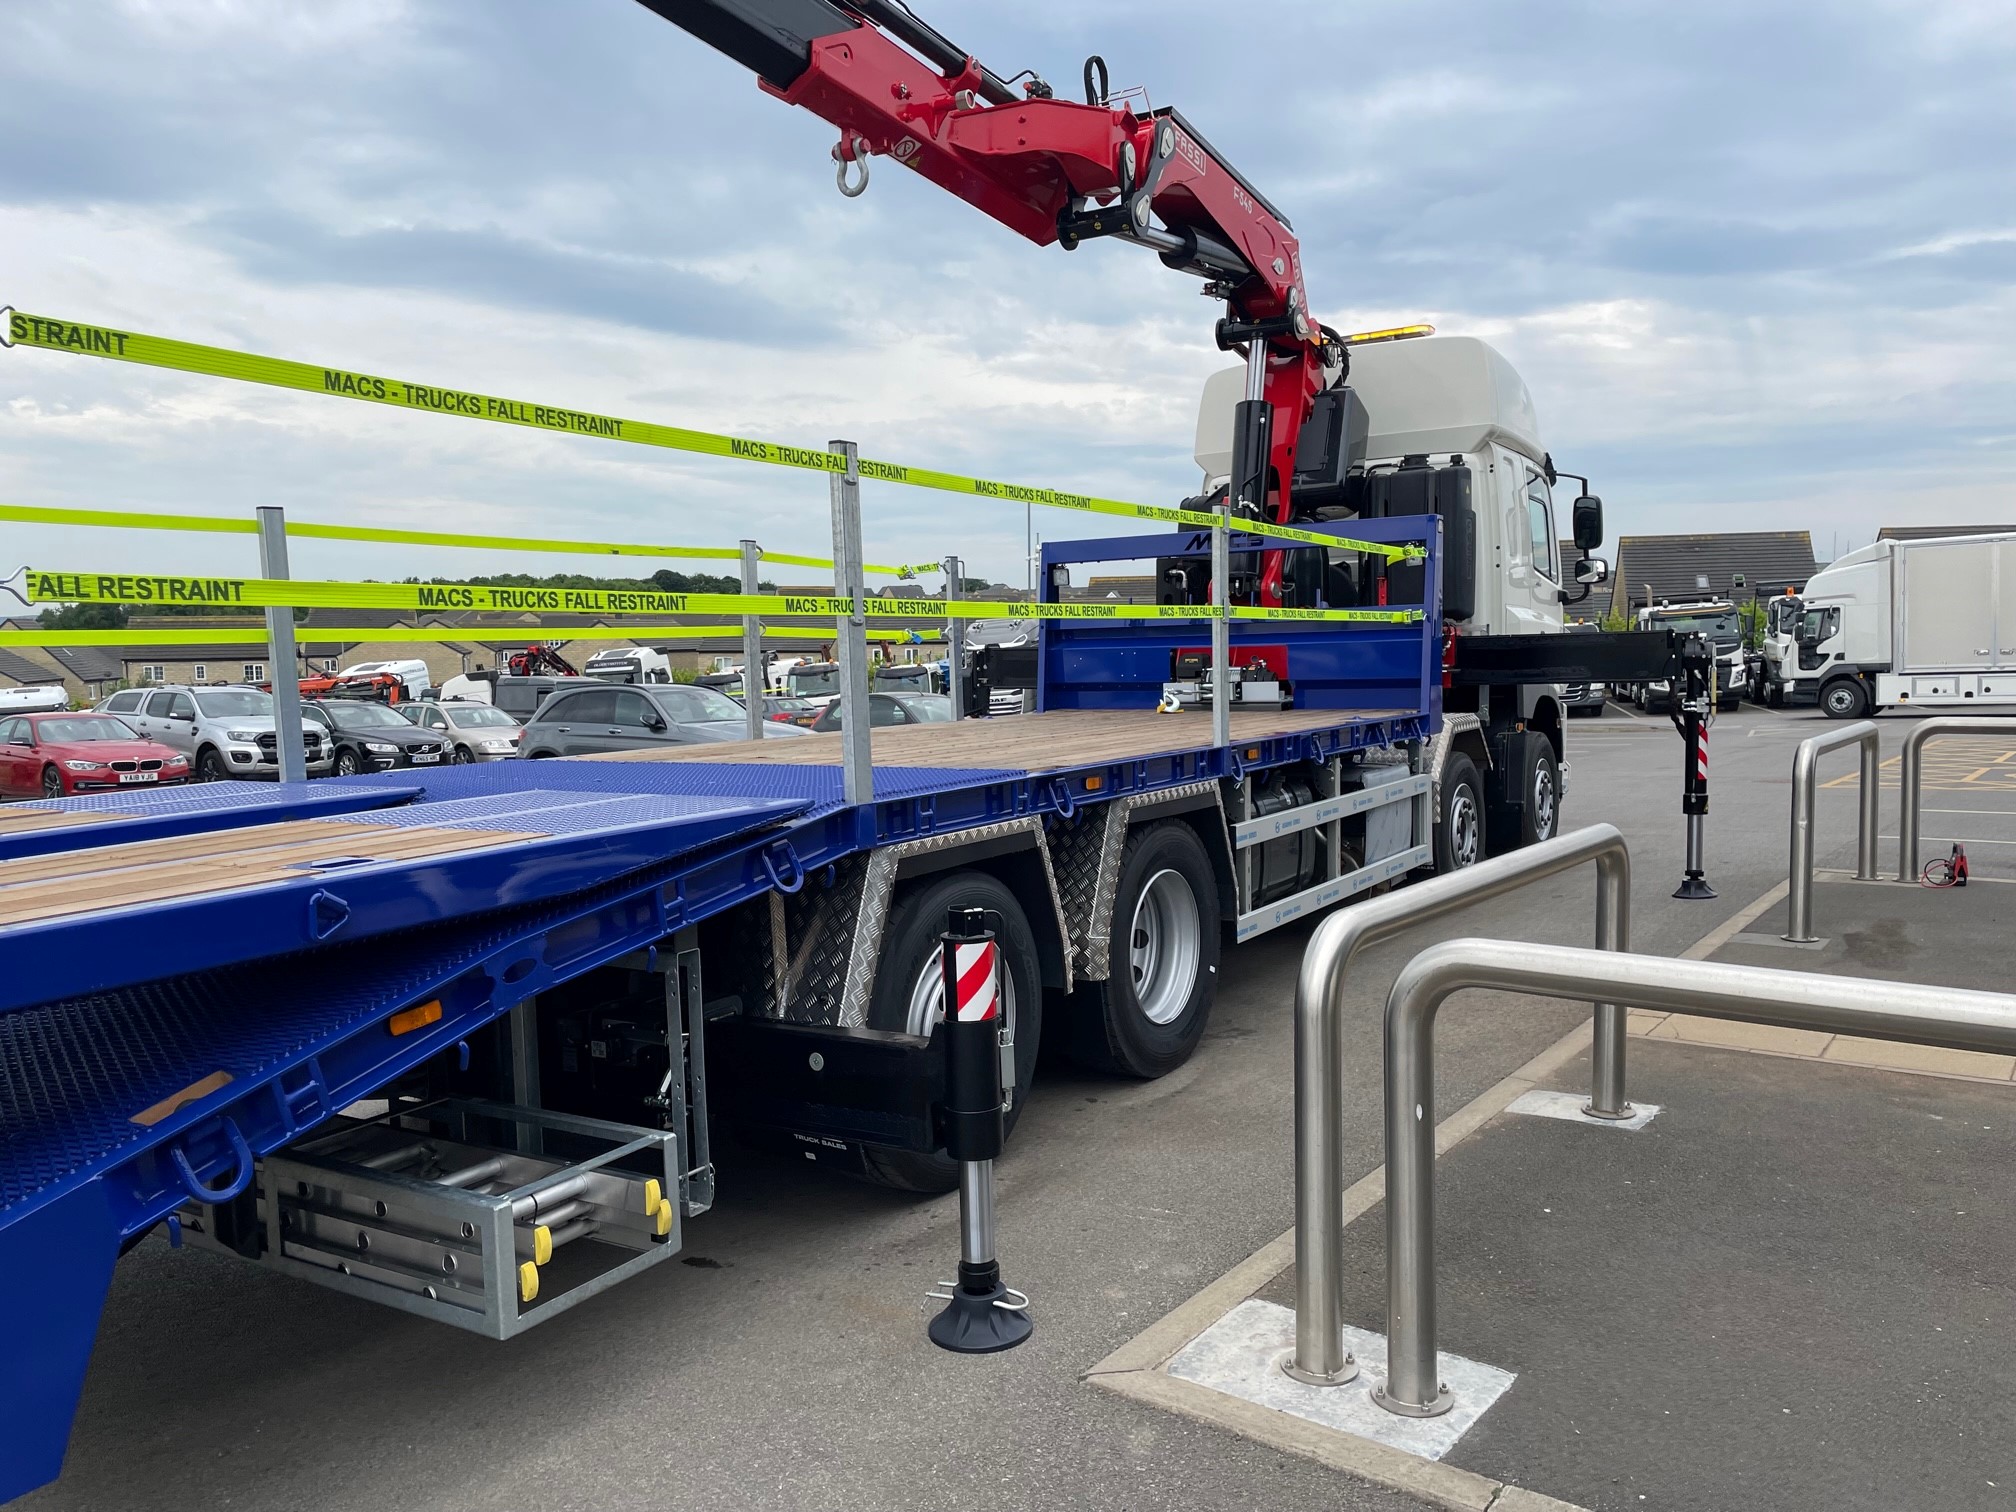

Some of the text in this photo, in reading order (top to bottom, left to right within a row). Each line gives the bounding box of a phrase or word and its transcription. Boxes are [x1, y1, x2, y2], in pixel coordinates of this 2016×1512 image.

[1175, 130, 1204, 169] FASSI
[324, 371, 386, 399] MACS
[403, 384, 481, 414] TRUCKS
[488, 398, 530, 422] FALL
[534, 407, 623, 437] RESTRAINT
[731, 439, 767, 458] MACS
[776, 447, 822, 468] TRUCKS
[975, 480, 998, 494] MACS
[1004, 484, 1034, 500] TRUCKS
[1036, 490, 1053, 503] FALL
[1054, 493, 1092, 508] RESTRAINT
[1137, 505, 1153, 516] MACS
[1158, 508, 1179, 520] TRUCKS
[1180, 512, 1193, 522] FALL
[1194, 513, 1220, 524] RESTRAINT
[1184, 534, 1264, 551] MCS
[98, 576, 244, 601] RESTRAINT
[418, 588, 474, 607] MACS
[489, 590, 559, 608] TRUCKS
[565, 592, 604, 610] FALL
[608, 594, 688, 610] RESTRAINT
[786, 598, 817, 612] MACS
[827, 600, 868, 613] TRUCS
[872, 600, 895, 614] FALL
[898, 602, 946, 615] RESTRAINT
[1008, 605, 1029, 616] MACS
[1036, 605, 1062, 616] TRUCKS
[1065, 606, 1081, 616] FALL
[1082, 606, 1116, 617] RESTRAINT
[1159, 607, 1174, 616] MACS
[1178, 607, 1198, 616] TRUCKS
[1200, 607, 1211, 616] FALL
[1213, 607, 1237, 616] RESTNT
[794, 1134, 847, 1150] TRUCK SALES
